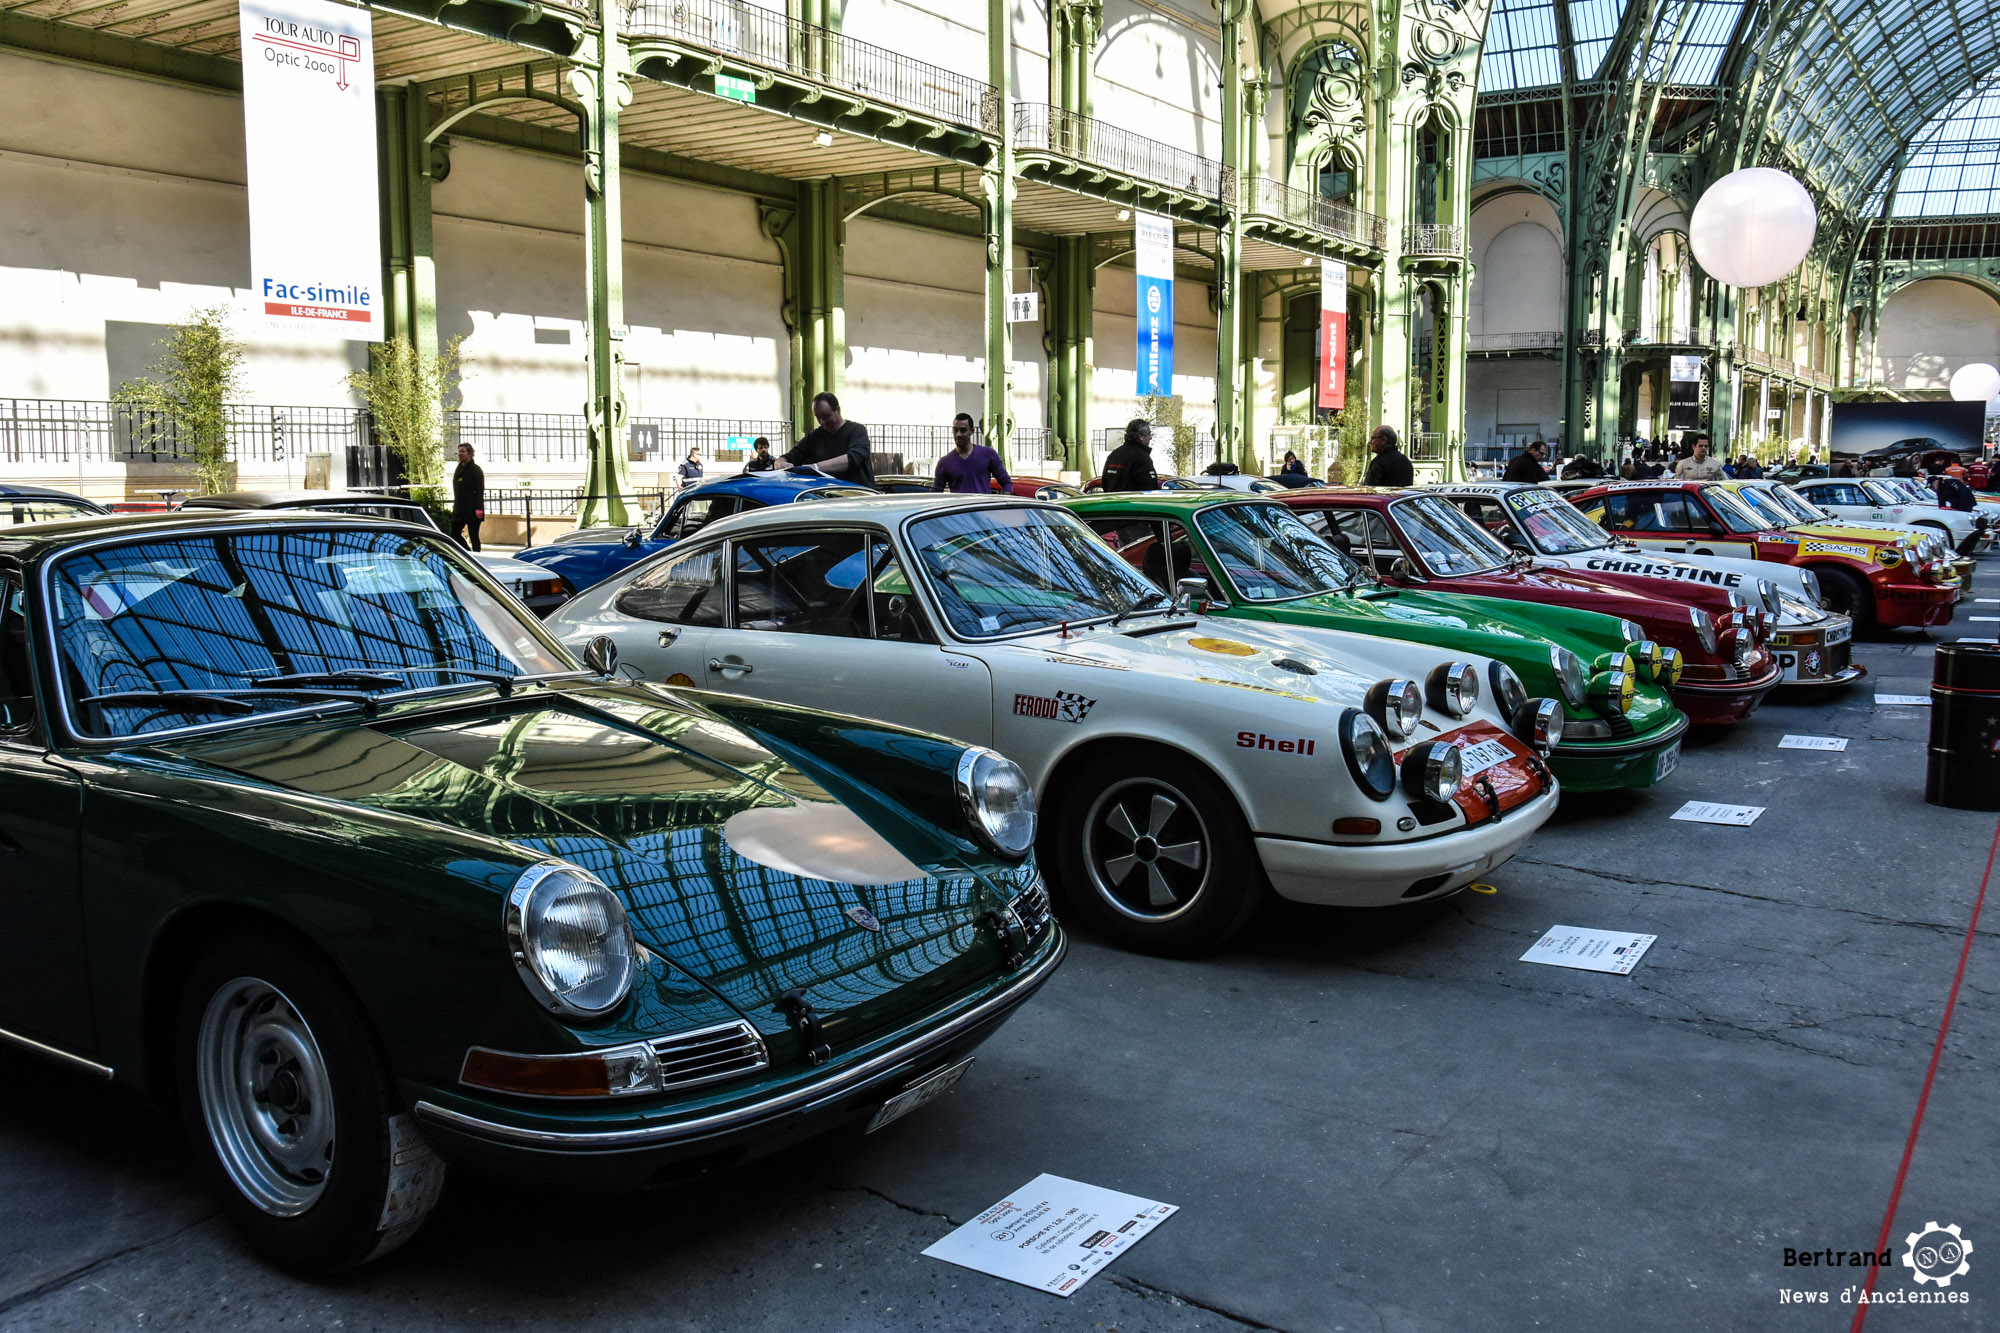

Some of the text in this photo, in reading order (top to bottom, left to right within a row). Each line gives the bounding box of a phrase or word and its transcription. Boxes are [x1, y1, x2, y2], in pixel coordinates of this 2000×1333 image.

[264, 17, 334, 45] TOUR AUTO
[265, 47, 335, 74] Optic 2000
[263, 278, 370, 306] Fac-similé
[291, 306, 348, 319] ILE-DE-FRANCE
[1150, 316, 1159, 388] Allianz
[1329, 322, 1337, 367] Point
[1450, 487, 1501, 495] LAURE
[1824, 543, 1866, 555] SACHS
[1586, 559, 1742, 588] CHRISTINE
[1014, 694, 1059, 718] FERODO
[1236, 732, 1315, 756] Shell
[1018, 1230, 1047, 1249] PORSCHE
